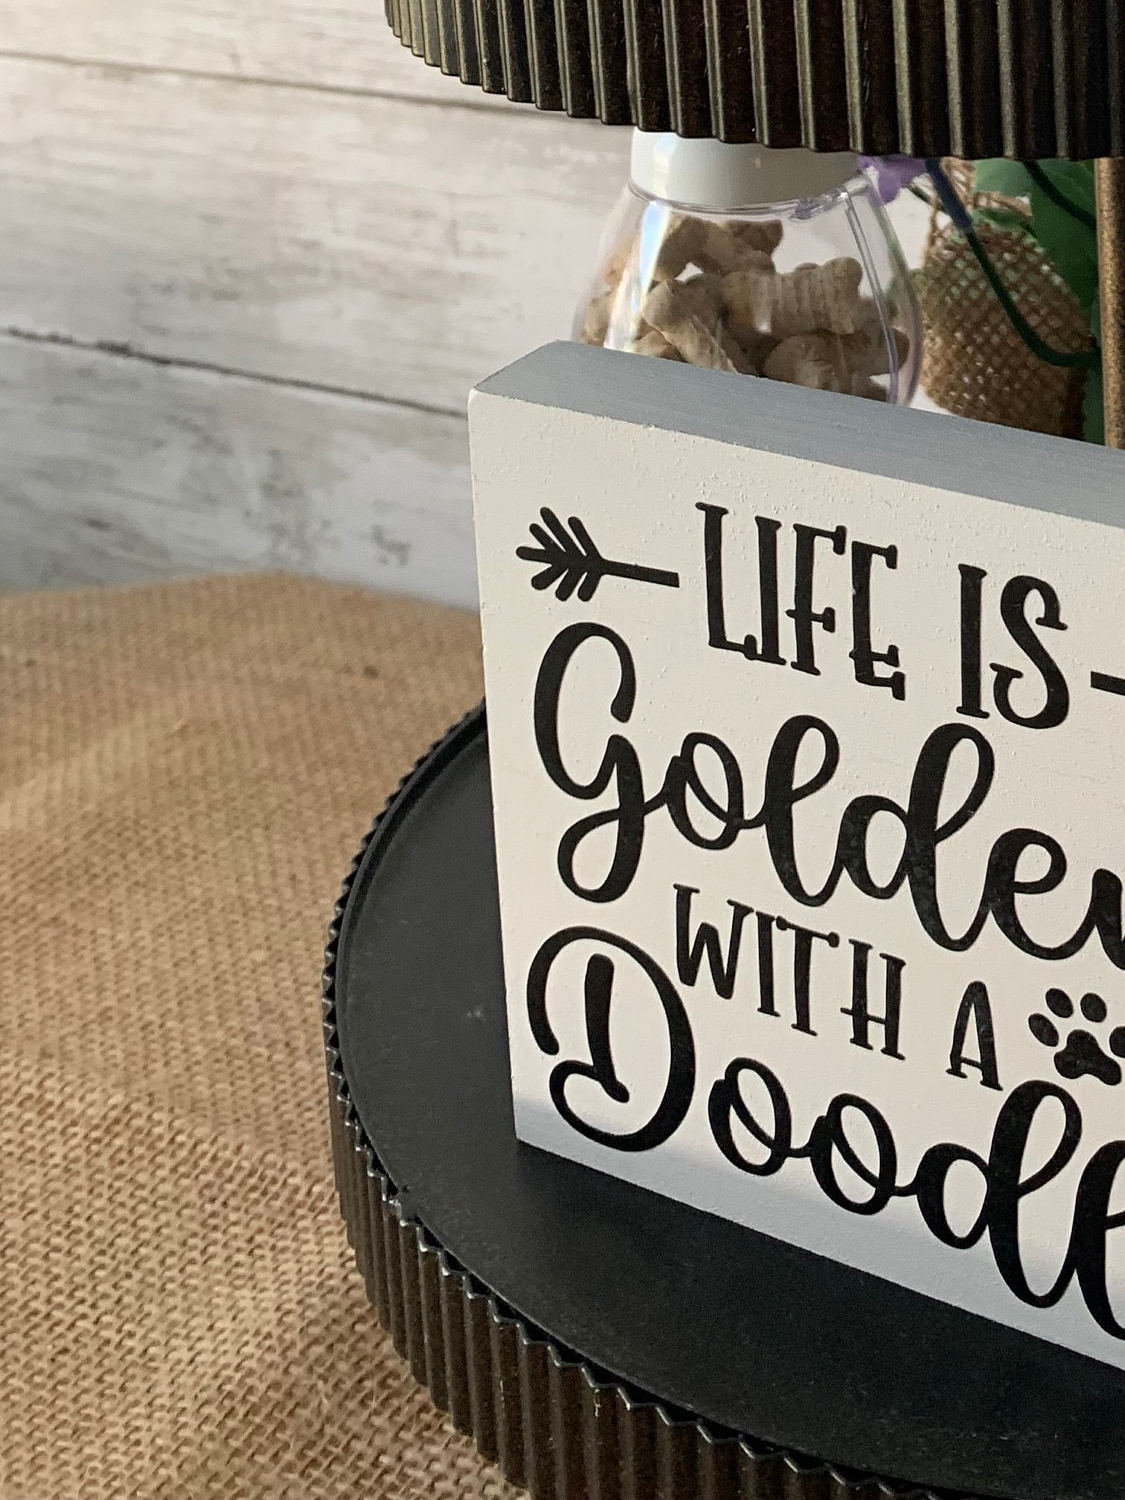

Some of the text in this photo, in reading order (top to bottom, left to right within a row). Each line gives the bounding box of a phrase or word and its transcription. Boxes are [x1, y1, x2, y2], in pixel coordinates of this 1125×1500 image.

[696, 502, 1069, 730] LIFE IS
[673, 885, 1003, 1091] WITH A
